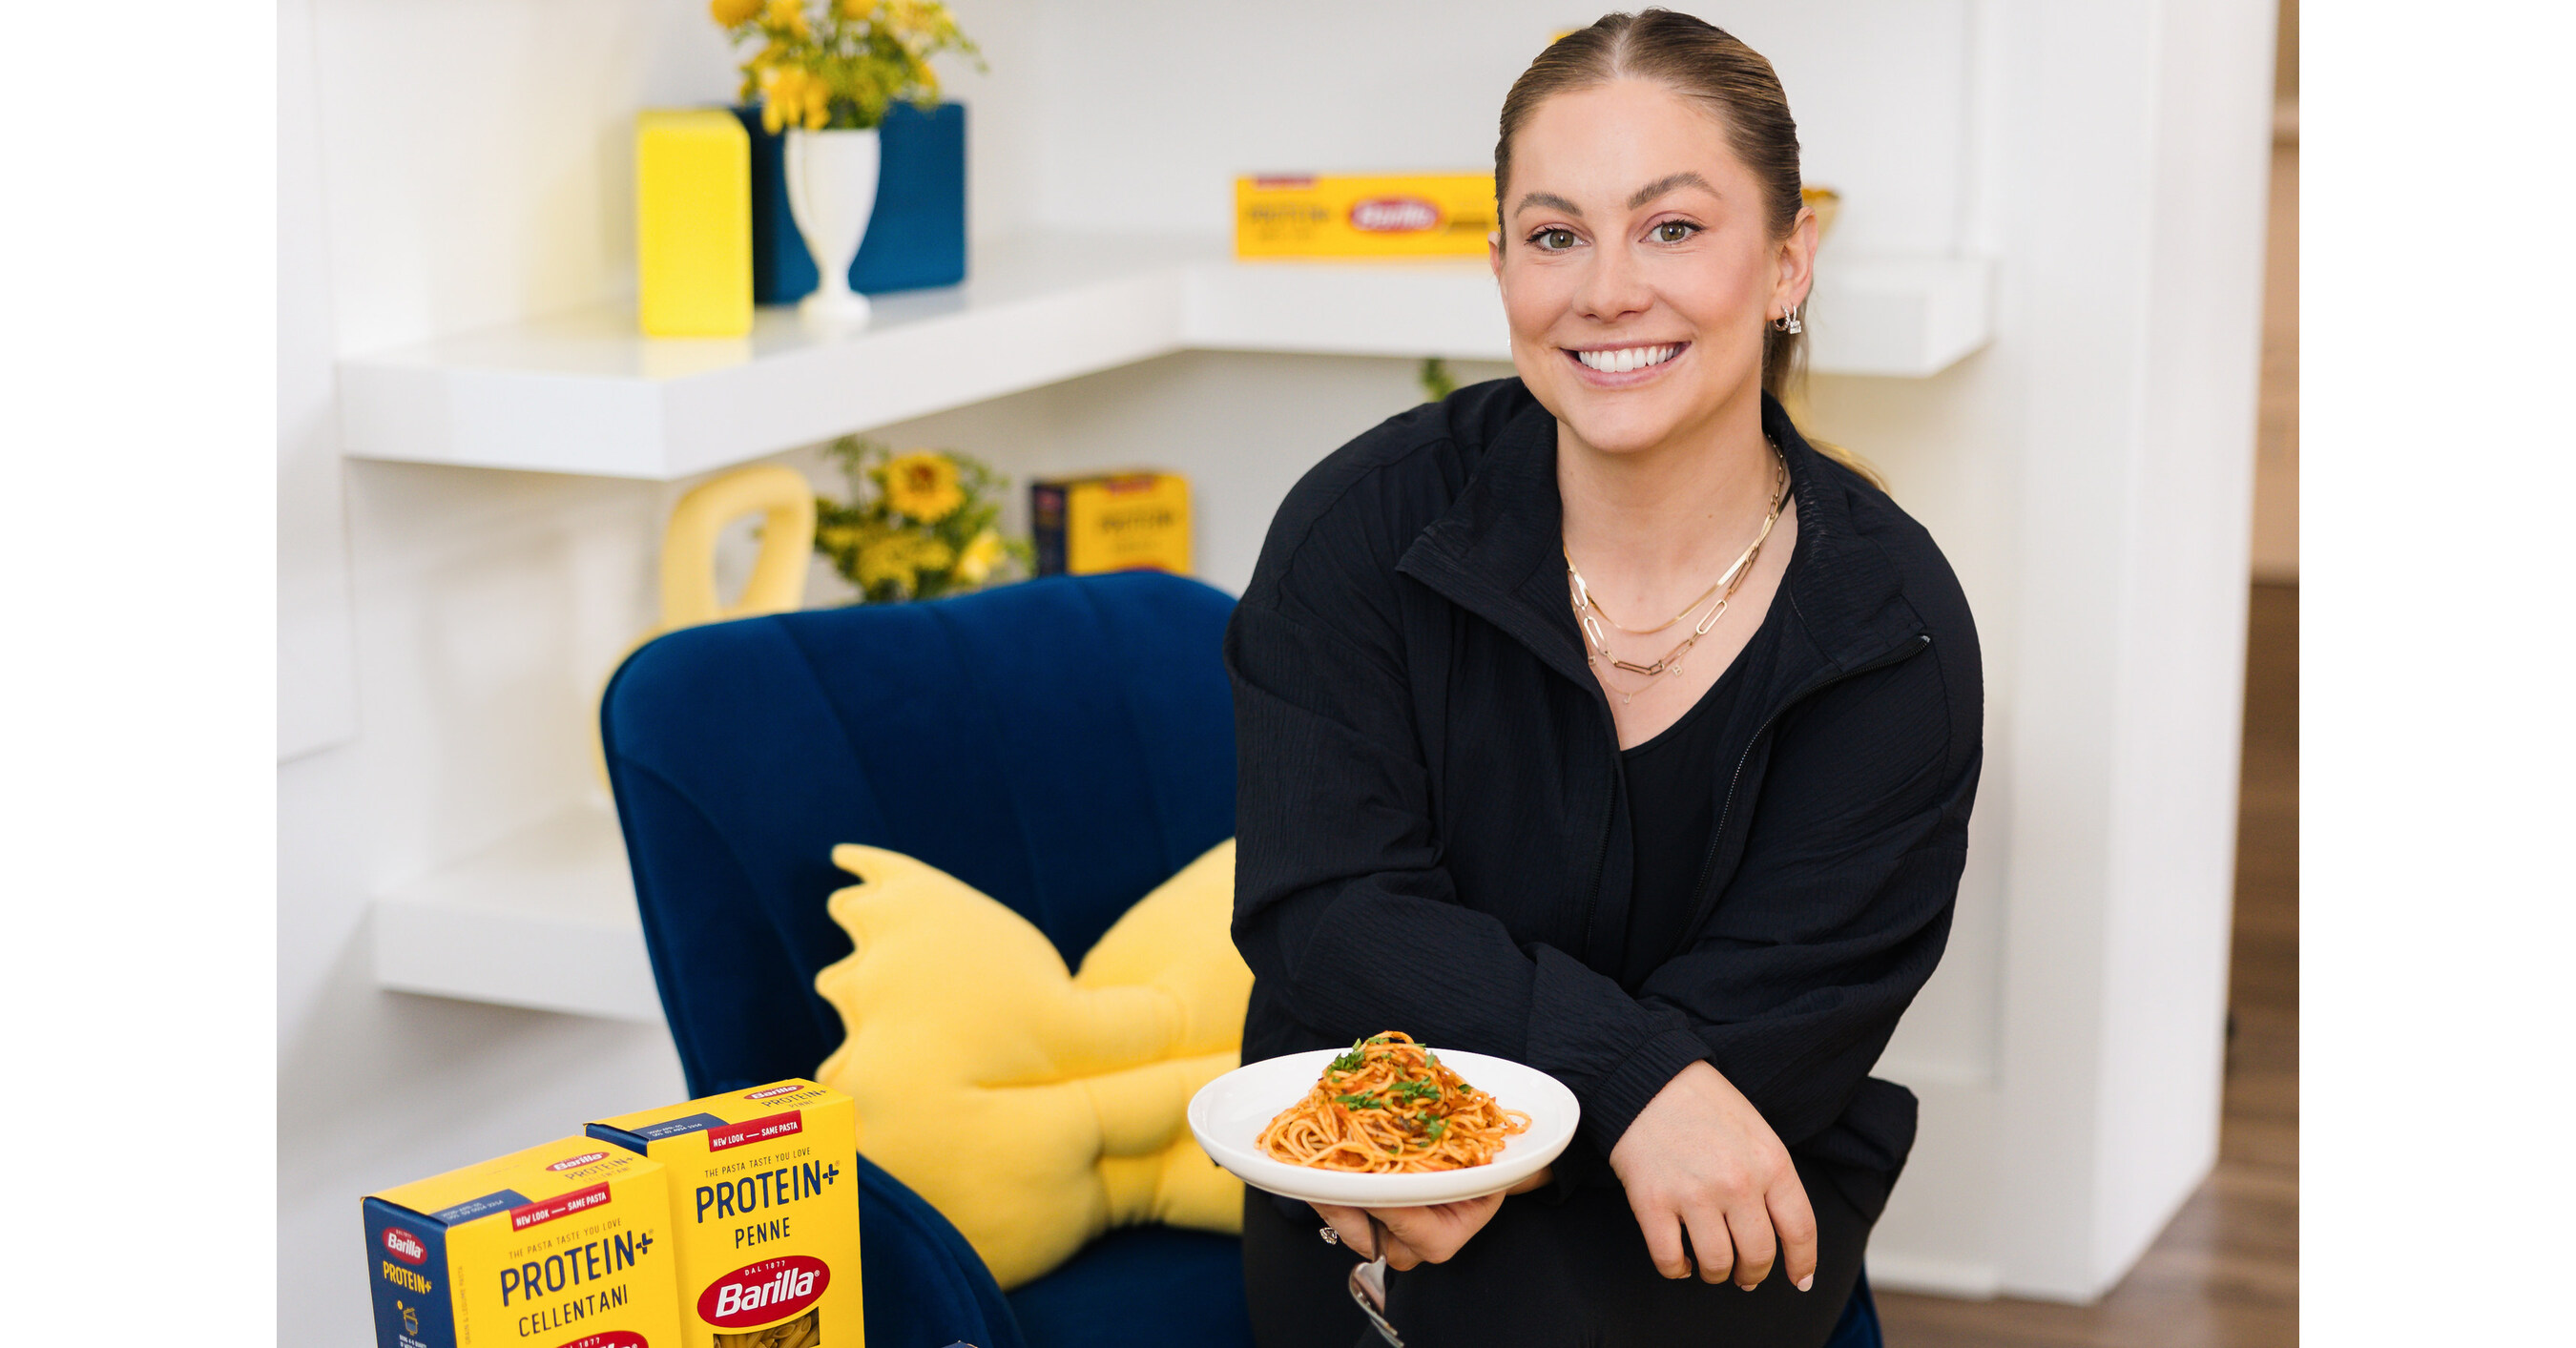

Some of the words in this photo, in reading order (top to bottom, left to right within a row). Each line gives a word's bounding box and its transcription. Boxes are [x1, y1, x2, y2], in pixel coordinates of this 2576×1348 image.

[713, 1138, 727, 1148] NEW
[728, 1133, 744, 1144] LOOK
[761, 1127, 779, 1137] SAME
[779, 1121, 798, 1132] PASTA
[705, 1169, 718, 1178] THE
[721, 1162, 746, 1174] PASTA
[749, 1156, 772, 1169] TASTE
[776, 1152, 790, 1162] YOU
[793, 1147, 811, 1158] LOVE
[515, 1214, 531, 1227] NEW
[531, 1209, 550, 1222] LOOK
[568, 1197, 586, 1212] SAME
[586, 1192, 607, 1206] PASTA
[509, 1248, 524, 1259] THE
[527, 1241, 552, 1255] PASTA
[556, 1231, 580, 1244] TASTE
[584, 1226, 600, 1236] YOU
[603, 1217, 622, 1231] LOVE
[735, 1216, 790, 1249] PENNE
[744, 1266, 762, 1276] DAL
[765, 1260, 786, 1271] 1877
[519, 1284, 628, 1338] CELLENTANI
[579, 1337, 600, 1348] 1877
